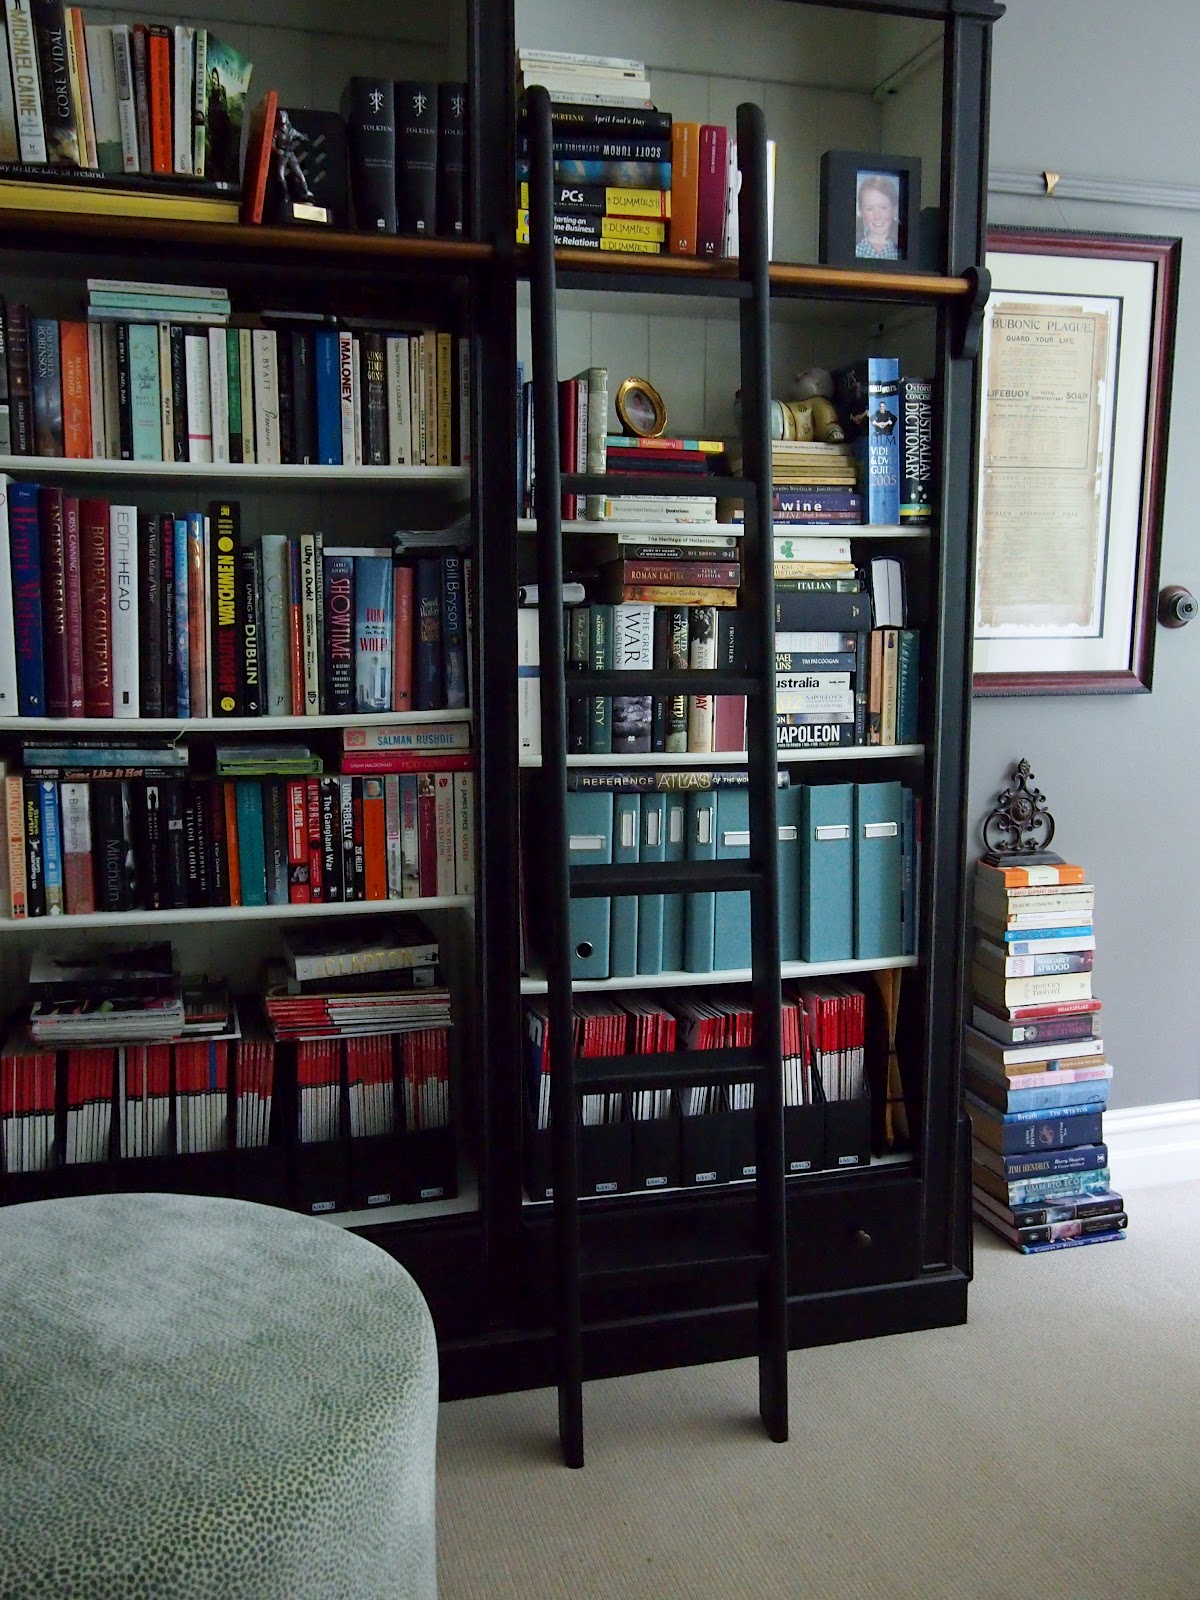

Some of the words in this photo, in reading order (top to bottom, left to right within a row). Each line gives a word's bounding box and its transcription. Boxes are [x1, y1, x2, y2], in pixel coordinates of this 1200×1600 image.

[10, 10, 34, 72] MICHAEL
[50, 28, 66, 74] VIDAL
[17, 74, 38, 117] CAINE
[55, 77, 70, 118] GORE
[362, 124, 392, 133] TOLKIEN
[405, 127, 435, 135] TOLKIEN
[594, 114, 610, 125] April
[632, 117, 646, 126] Day
[603, 145, 633, 157] TUROW
[636, 147, 661, 157] SCOTT
[561, 190, 584, 202] PCs
[613, 196, 655, 208] DUMMIES
[566, 224, 595, 233] Business
[609, 223, 650, 235] DUMMIES
[562, 236, 598, 248] Relations
[609, 241, 649, 251] DUMMIES
[992, 318, 1040, 330] BUBONIC
[37, 326, 46, 378] ROBINSON
[340, 342, 351, 402] MALONEY
[905, 383, 931, 393] Oxford
[905, 402, 919, 481] DICTIONARY
[920, 403, 931, 481] AUSTRALIAN
[872, 475, 896, 486] 2005
[782, 501, 822, 511] wine
[68, 512, 76, 533] CRISS
[13, 507, 39, 570] Henri
[51, 504, 61, 566] ANCIENT
[148, 535, 156, 557] World
[69, 535, 77, 572] CANNING
[303, 545, 312, 565] Why
[90, 526, 106, 604] BORDEAUX
[148, 558, 156, 576] Atlas
[445, 558, 458, 580] Bill
[631, 571, 657, 579] ROMAN
[148, 585, 156, 603] Wine
[217, 555, 235, 626] WATCHMEN
[305, 577, 314, 602] Duck?
[797, 581, 832, 590] ITALIAN
[53, 572, 64, 634] IRELAND
[70, 590, 78, 623] PURSUIT
[447, 581, 459, 630] Bryson
[17, 582, 39, 661] Matisse
[248, 613, 253, 623] IN
[330, 578, 351, 659] SHOWTIME
[366, 608, 385, 622] TOM
[625, 612, 641, 664] WAR
[673, 613, 681, 657] STARKEY
[94, 609, 108, 688] CHATEAUX
[244, 624, 258, 685] DUBLIN
[615, 630, 623, 664] CARLYON
[642, 632, 650, 664] GREAT
[217, 628, 238, 693] ABSOLUTE
[596, 649, 604, 670] THE
[378, 736, 412, 745] SALMAN
[416, 734, 455, 744] RUSHDIE
[64, 770, 91, 780] Some
[93, 769, 114, 779] Like
[116, 769, 124, 778] It
[125, 768, 144, 777] Hot
[583, 778, 655, 786] REFERENCE
[657, 774, 712, 789] ATLAS
[69, 798, 79, 815] Bill
[294, 787, 302, 805] LINE
[324, 795, 332, 810] The
[9, 781, 21, 837] HOLLYWOOD
[27, 801, 36, 836] Martin
[295, 810, 303, 827] FIRE
[308, 785, 319, 839] UNDERBELLY
[342, 783, 352, 839] UNDERBELLY
[70, 816, 79, 849] Bryson
[323, 812, 333, 852] Gangland
[11, 842, 24, 893] HANDBOOK
[106, 839, 120, 902] Mitchum
[189, 843, 198, 880] RODDY
[325, 854, 333, 871] War
[30, 880, 37, 890] up
[324, 951, 414, 977] CLAPTON
[1037, 964, 1070, 972] ATWOOD
[1022, 1161, 1050, 1172] HENDRIX
[1026, 1180, 1062, 1192] UMBERTO
[1064, 1177, 1080, 1187] ECO
